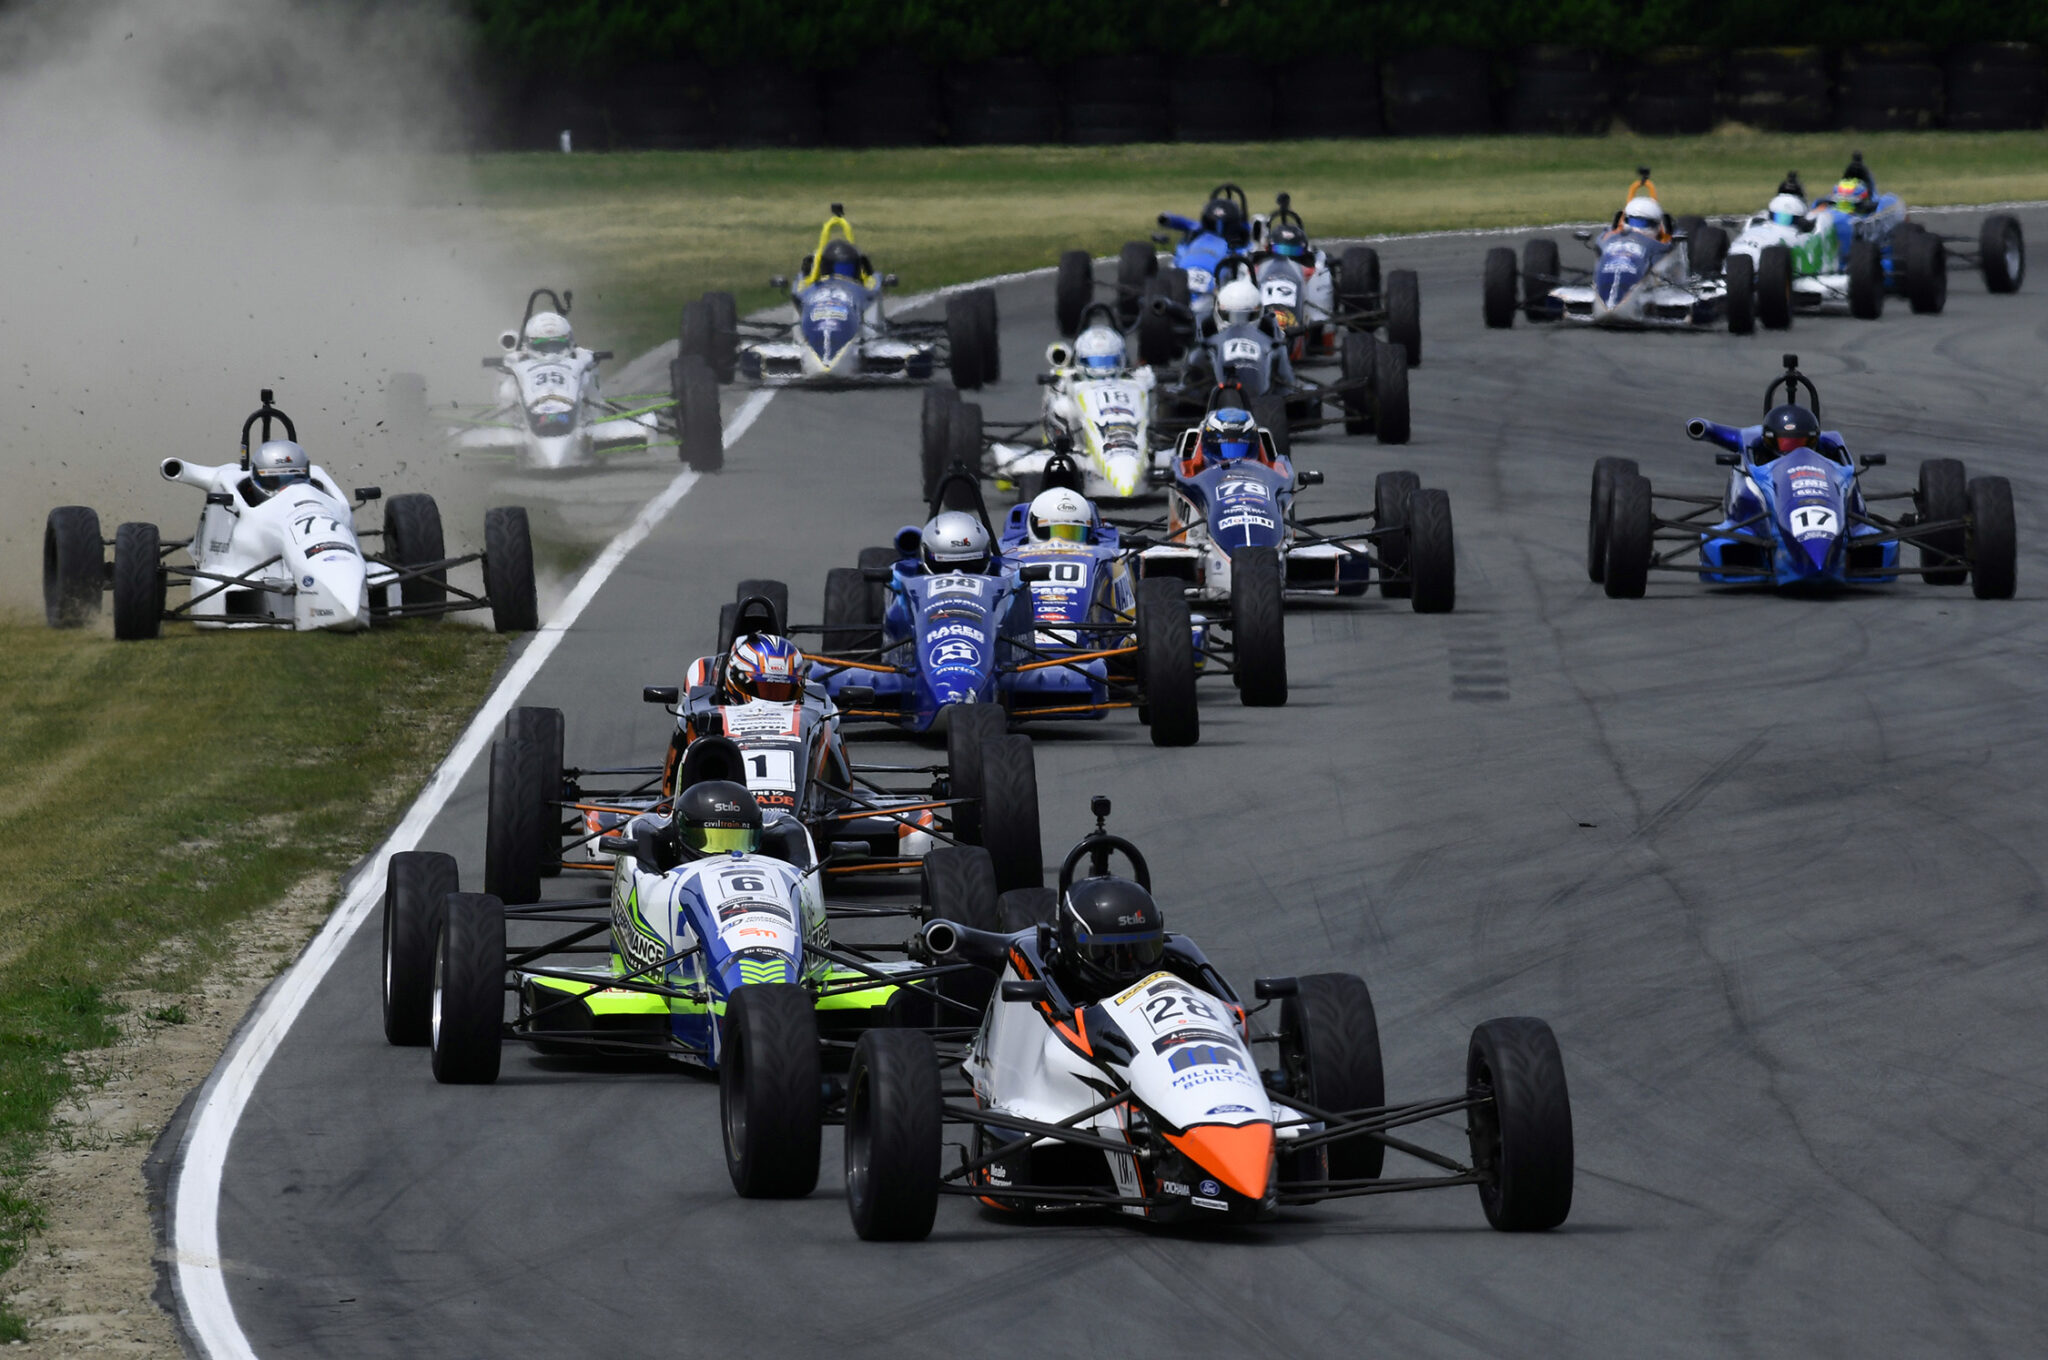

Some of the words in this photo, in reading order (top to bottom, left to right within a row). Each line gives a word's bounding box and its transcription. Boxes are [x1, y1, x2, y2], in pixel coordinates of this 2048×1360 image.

[1218, 482, 1267, 497] 78
[295, 515, 341, 535] 77
[1221, 517, 1258, 526] Mobil
[1795, 509, 1832, 527] 17
[748, 754, 768, 778] 1
[714, 801, 741, 812] Stilo
[731, 876, 765, 891] 6
[1117, 910, 1146, 926] Stilo
[1145, 995, 1219, 1025] 28
[1183, 1075, 1235, 1091] BUILT
